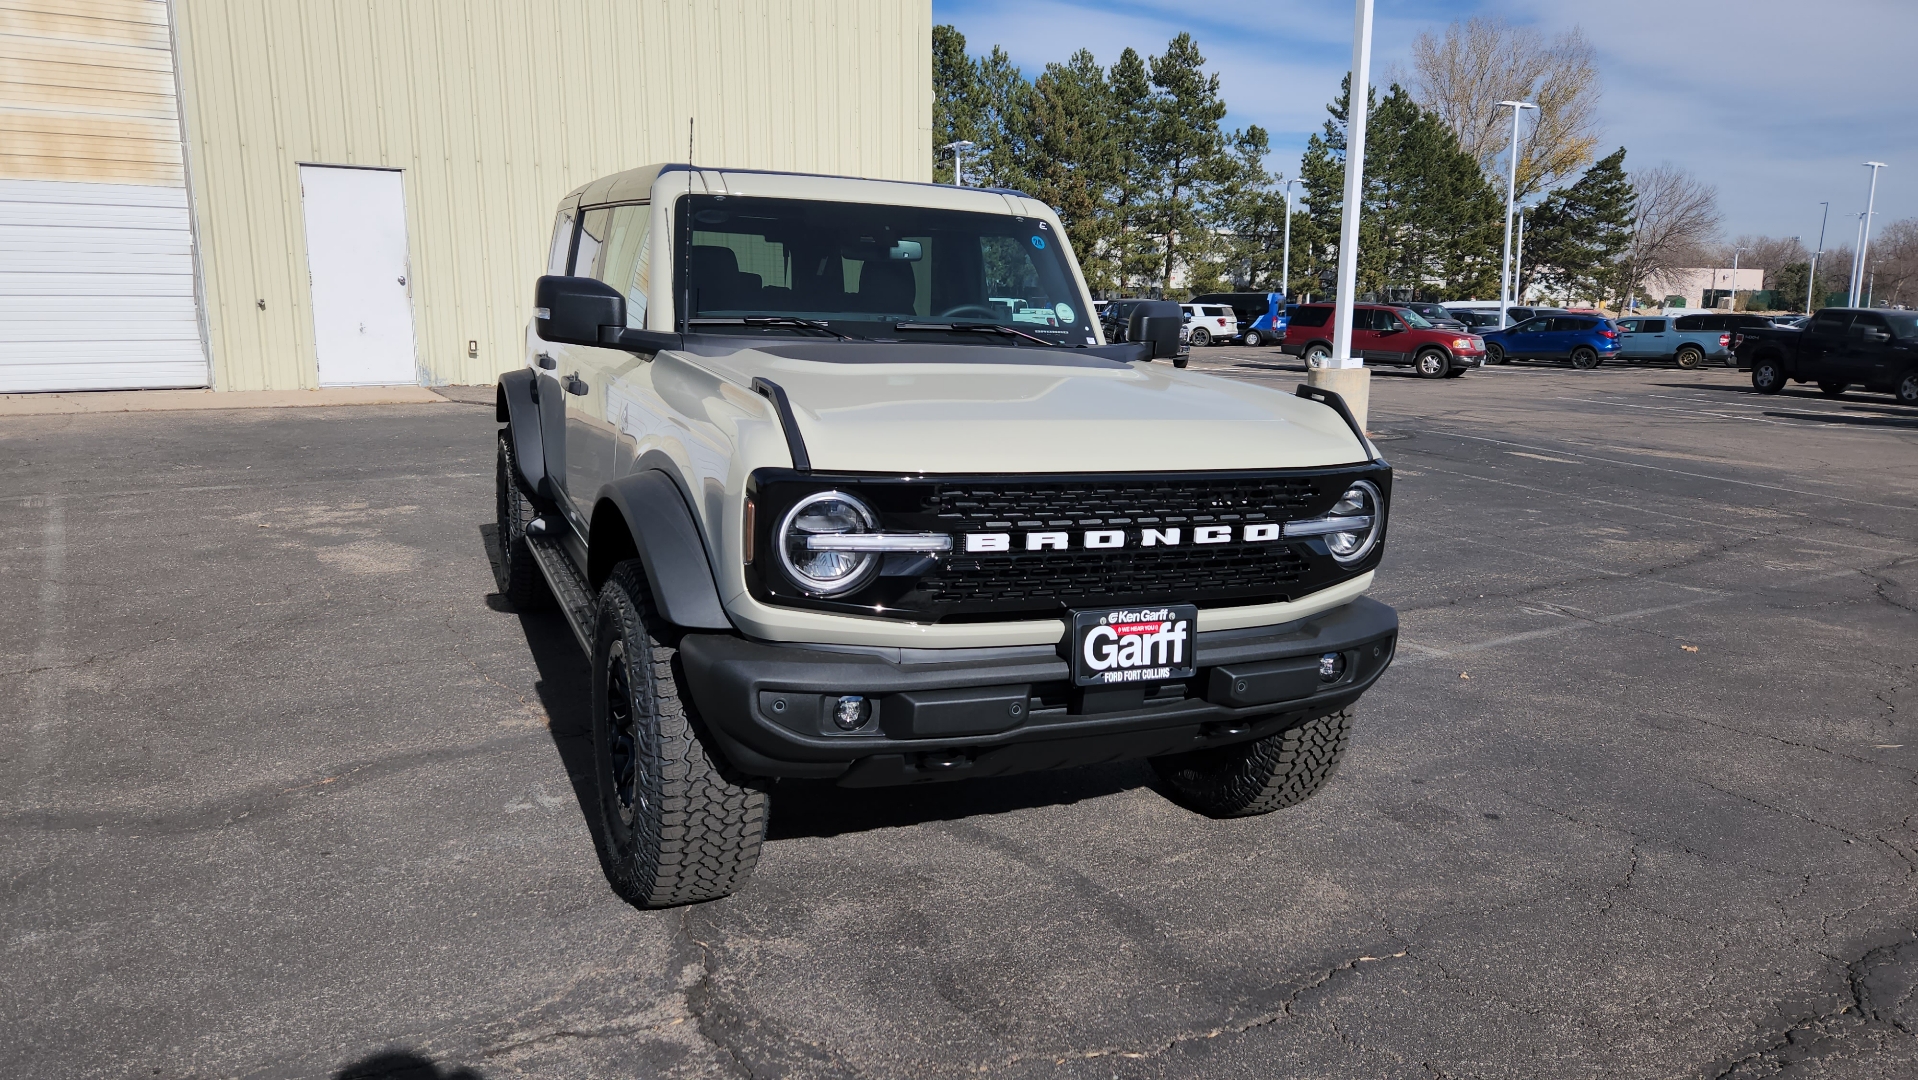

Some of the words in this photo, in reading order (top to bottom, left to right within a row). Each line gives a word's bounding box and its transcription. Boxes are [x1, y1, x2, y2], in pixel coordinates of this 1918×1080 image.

[965, 523, 1280, 552] BRONCO
[1118, 610, 1140, 623] Ken
[1141, 609, 1168, 622] Garff
[1084, 620, 1187, 670] Garff
[1104, 671, 1123, 683] FORD
[1124, 670, 1141, 682] FORT
[1142, 667, 1170, 680] COLLINS
